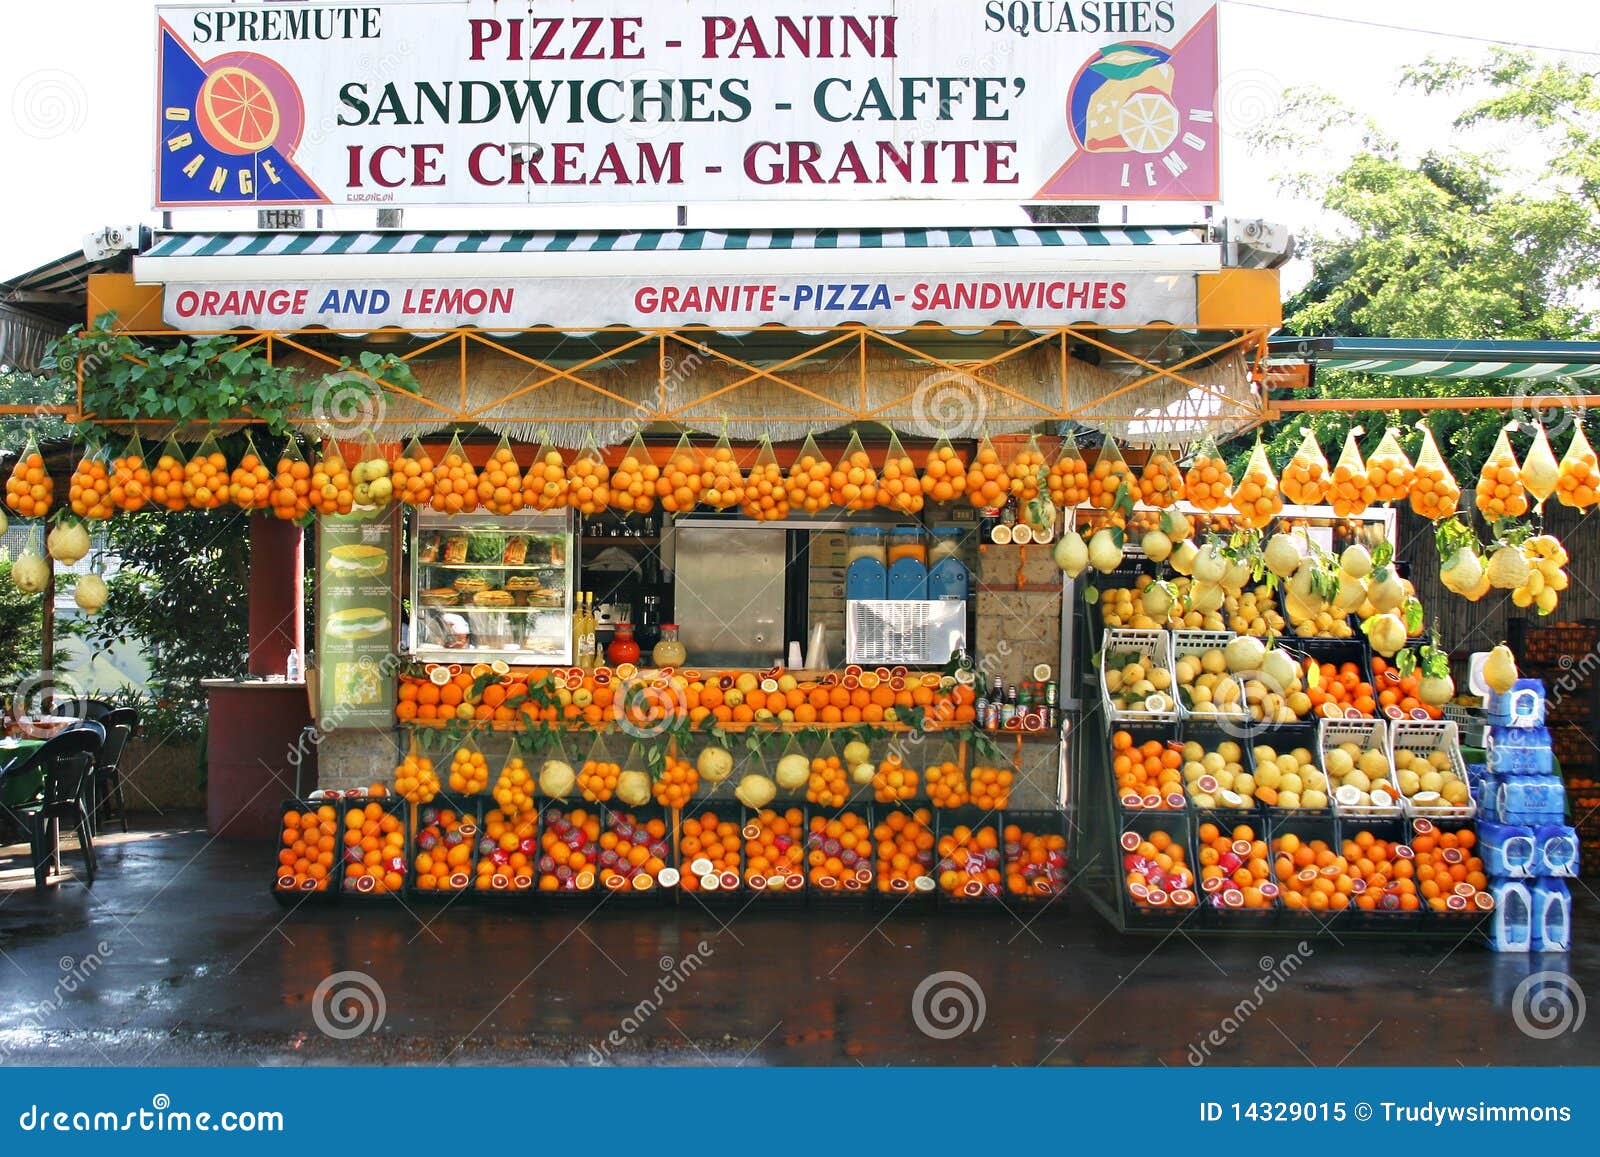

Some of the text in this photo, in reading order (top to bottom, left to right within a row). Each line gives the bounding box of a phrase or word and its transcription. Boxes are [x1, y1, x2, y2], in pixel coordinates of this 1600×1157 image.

[192, 8, 381, 43] SPREMUTE
[468, 15, 898, 61] PIZZE - PANINI
[985, 0, 1175, 36] SQUASHES
[337, 79, 752, 127] SANDWICHES
[774, 102, 792, 110] -
[165, 107, 281, 195] ORANGE
[346, 140, 1020, 188] ICE CREAM - GRANITE
[1121, 108, 1214, 187] LEMON
[176, 288, 514, 317] ORANGE AND LEMON
